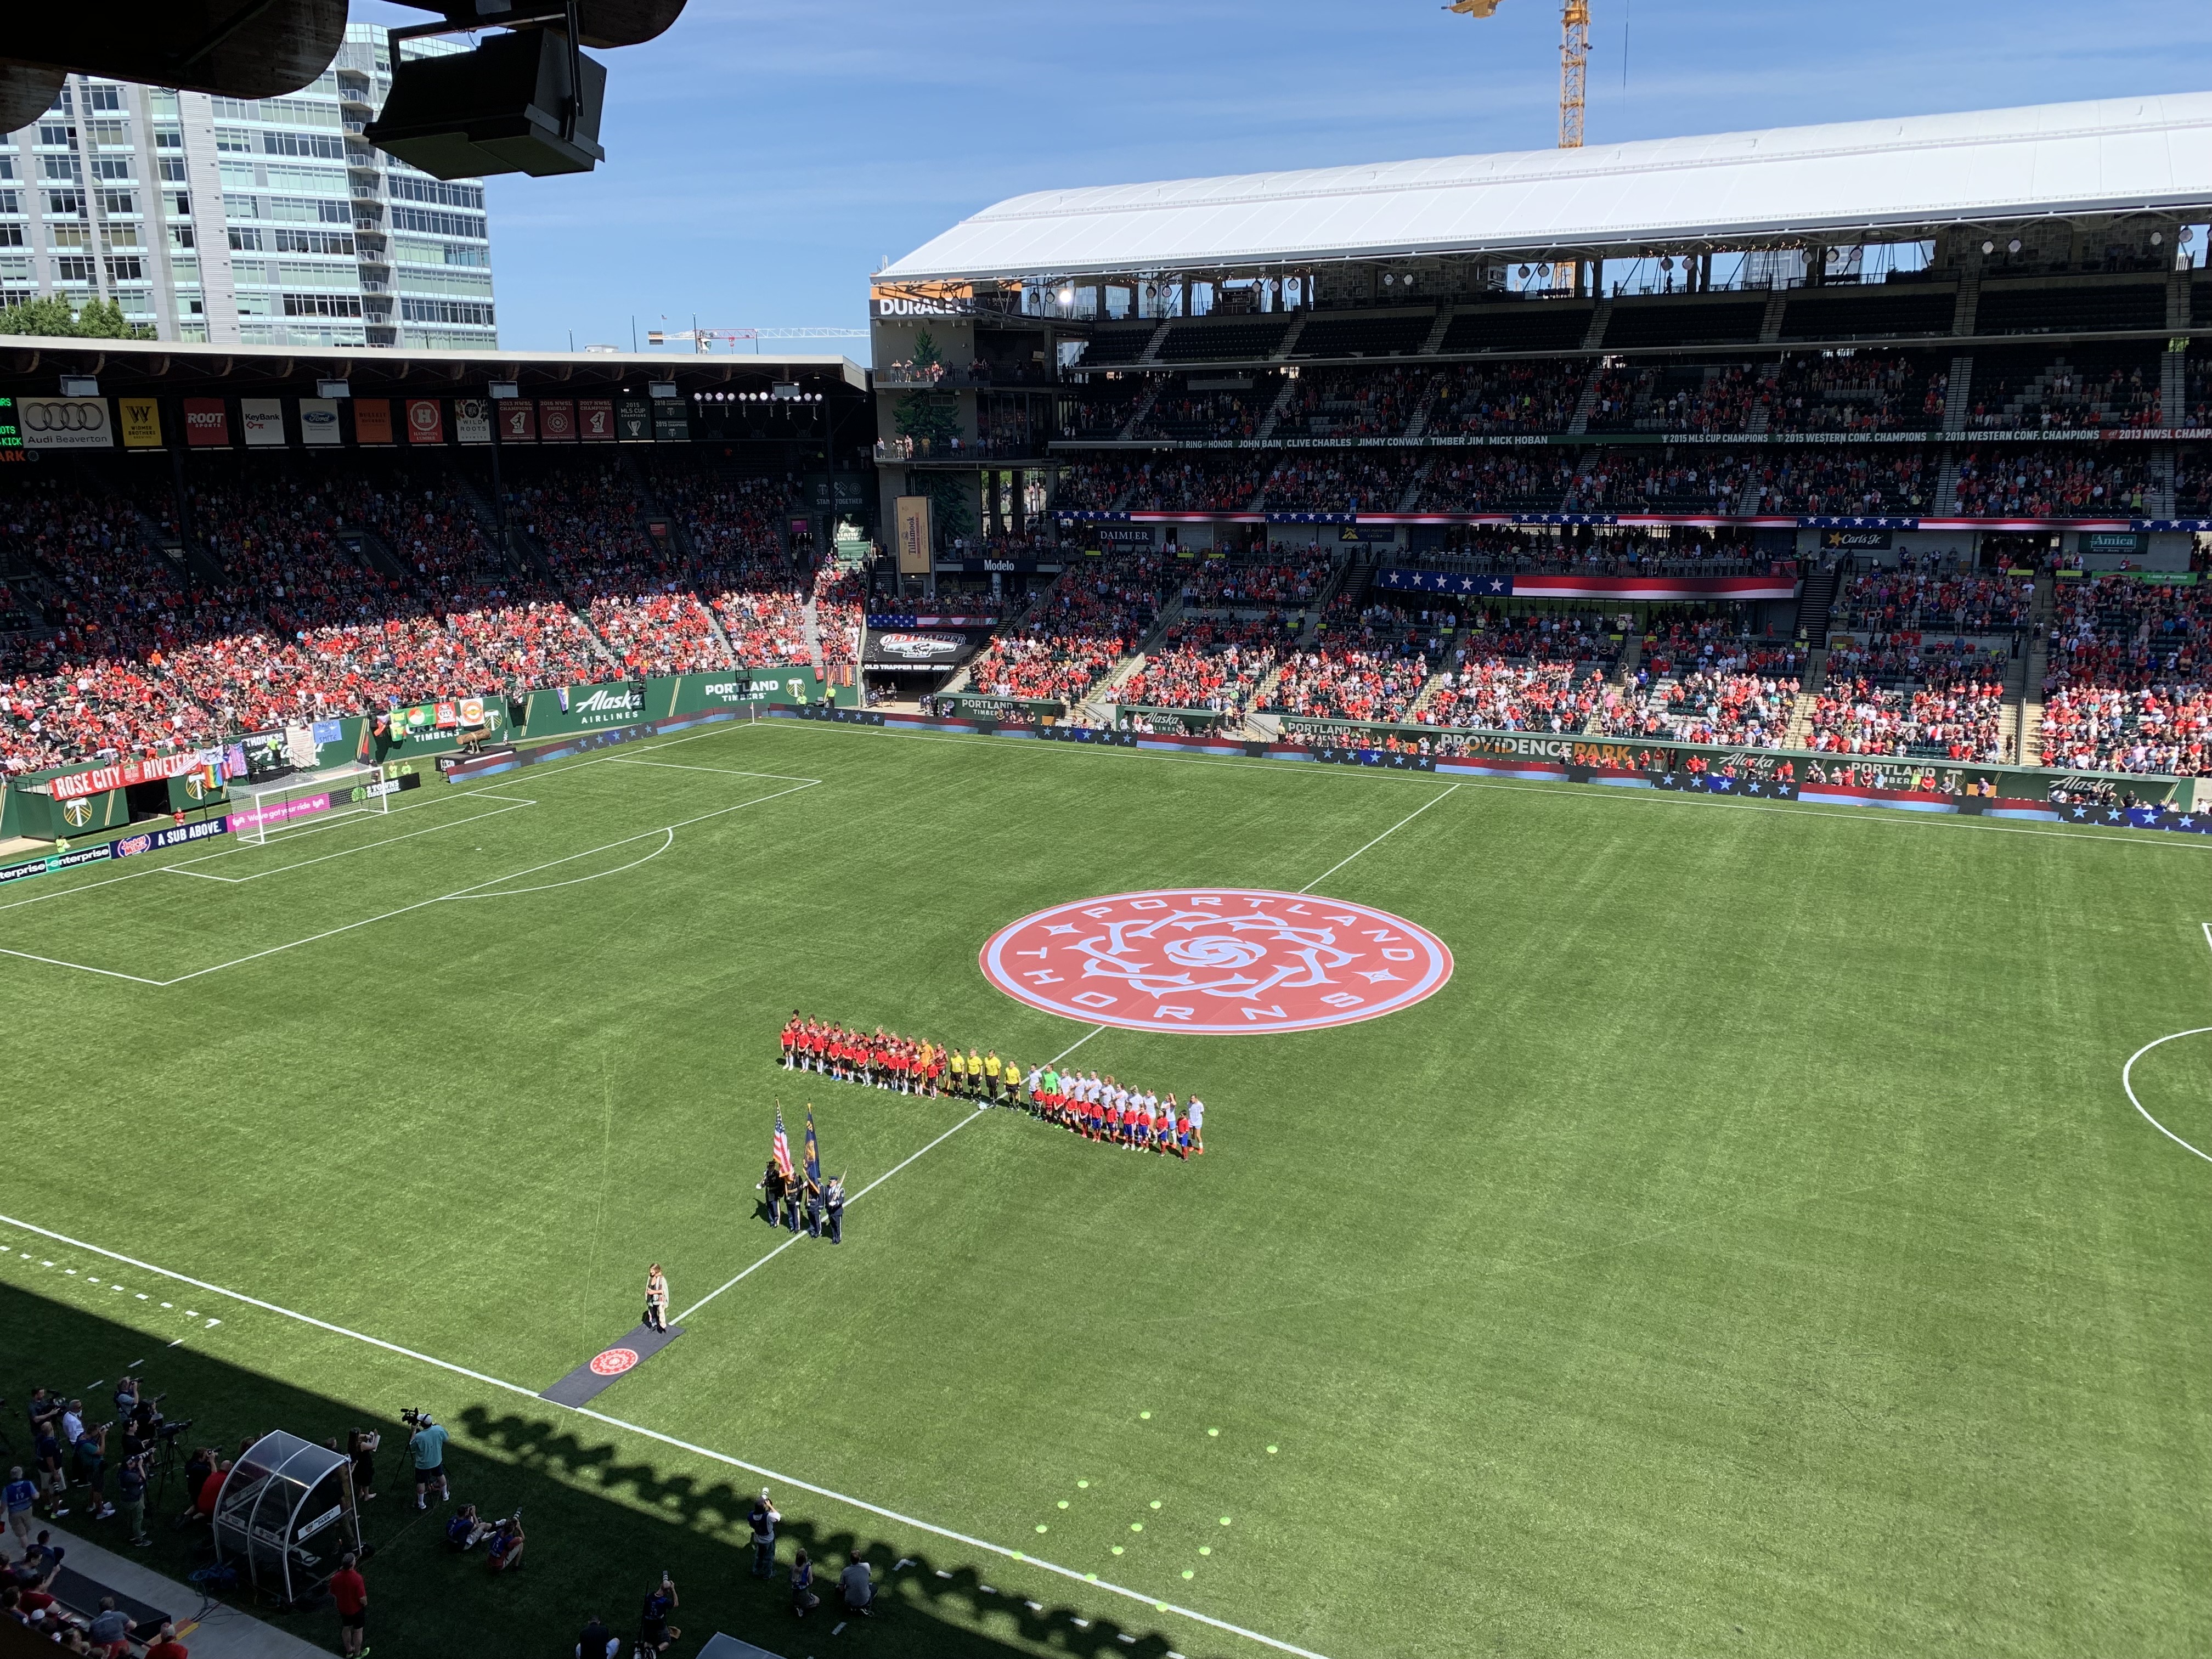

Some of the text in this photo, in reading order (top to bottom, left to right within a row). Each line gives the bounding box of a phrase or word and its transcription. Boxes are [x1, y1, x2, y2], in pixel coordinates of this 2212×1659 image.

[187, 412, 224, 424] ROOT
[309, 413, 330, 422] Ford
[0, 426, 16, 434] OTS
[2119, 431, 2141, 439] 2013
[2143, 430, 2172, 439] NWSL
[0, 437, 22, 445] KICK
[28, 435, 108, 444] Audi Beaverton
[1431, 437, 1483, 445] TIMBER JIM
[1489, 436, 1548, 445] MICK HOBAN
[1671, 434, 1768, 443] 2015 MLS CUP CHAMPIONS
[1785, 432, 1926, 442] 2015 WESTERN CONF. CHAMPIONS
[1945, 431, 2100, 441] 2018 WESTERN CONF. CHAMPIONS
[1286, 438, 1351, 447] CLIVE CHARLES
[1357, 438, 1424, 447] JIMMY CONWAY
[907, 516, 916, 555] Tillamook
[1101, 531, 1149, 540] DAIMLER
[1842, 534, 1881, 545] Carl's Jr.
[2096, 534, 2134, 545] Amica
[984, 560, 1015, 571] Modelo
[882, 633, 966, 643] OLD TRAPPER
[706, 680, 778, 695] PORTLAND
[575, 690, 642, 713] Alaska
[721, 693, 764, 702] TIMBERS
[962, 699, 1013, 709] PORTLAND
[582, 711, 638, 724] AIRLINES
[1141, 713, 1179, 725] Alaska
[1288, 723, 1351, 735] PORTLAND
[414, 730, 460, 742] TIMBERS
[1574, 742, 1633, 761] PARK
[55, 773, 92, 798] ROSE
[92, 765, 120, 791] CITY
[373, 780, 399, 793] TOWNS
[247, 812, 269, 823] Weve
[269, 809, 281, 819] got
[297, 802, 311, 811] ride
[157, 821, 222, 846] A SUB ABOVE.
[122, 836, 146, 848] Jersey
[47, 847, 109, 867] enterprise
[1082, 896, 1415, 961] PORTLAND
[1017, 947, 1365, 1021] THORNS
[318, 1516, 331, 1525] PARK
